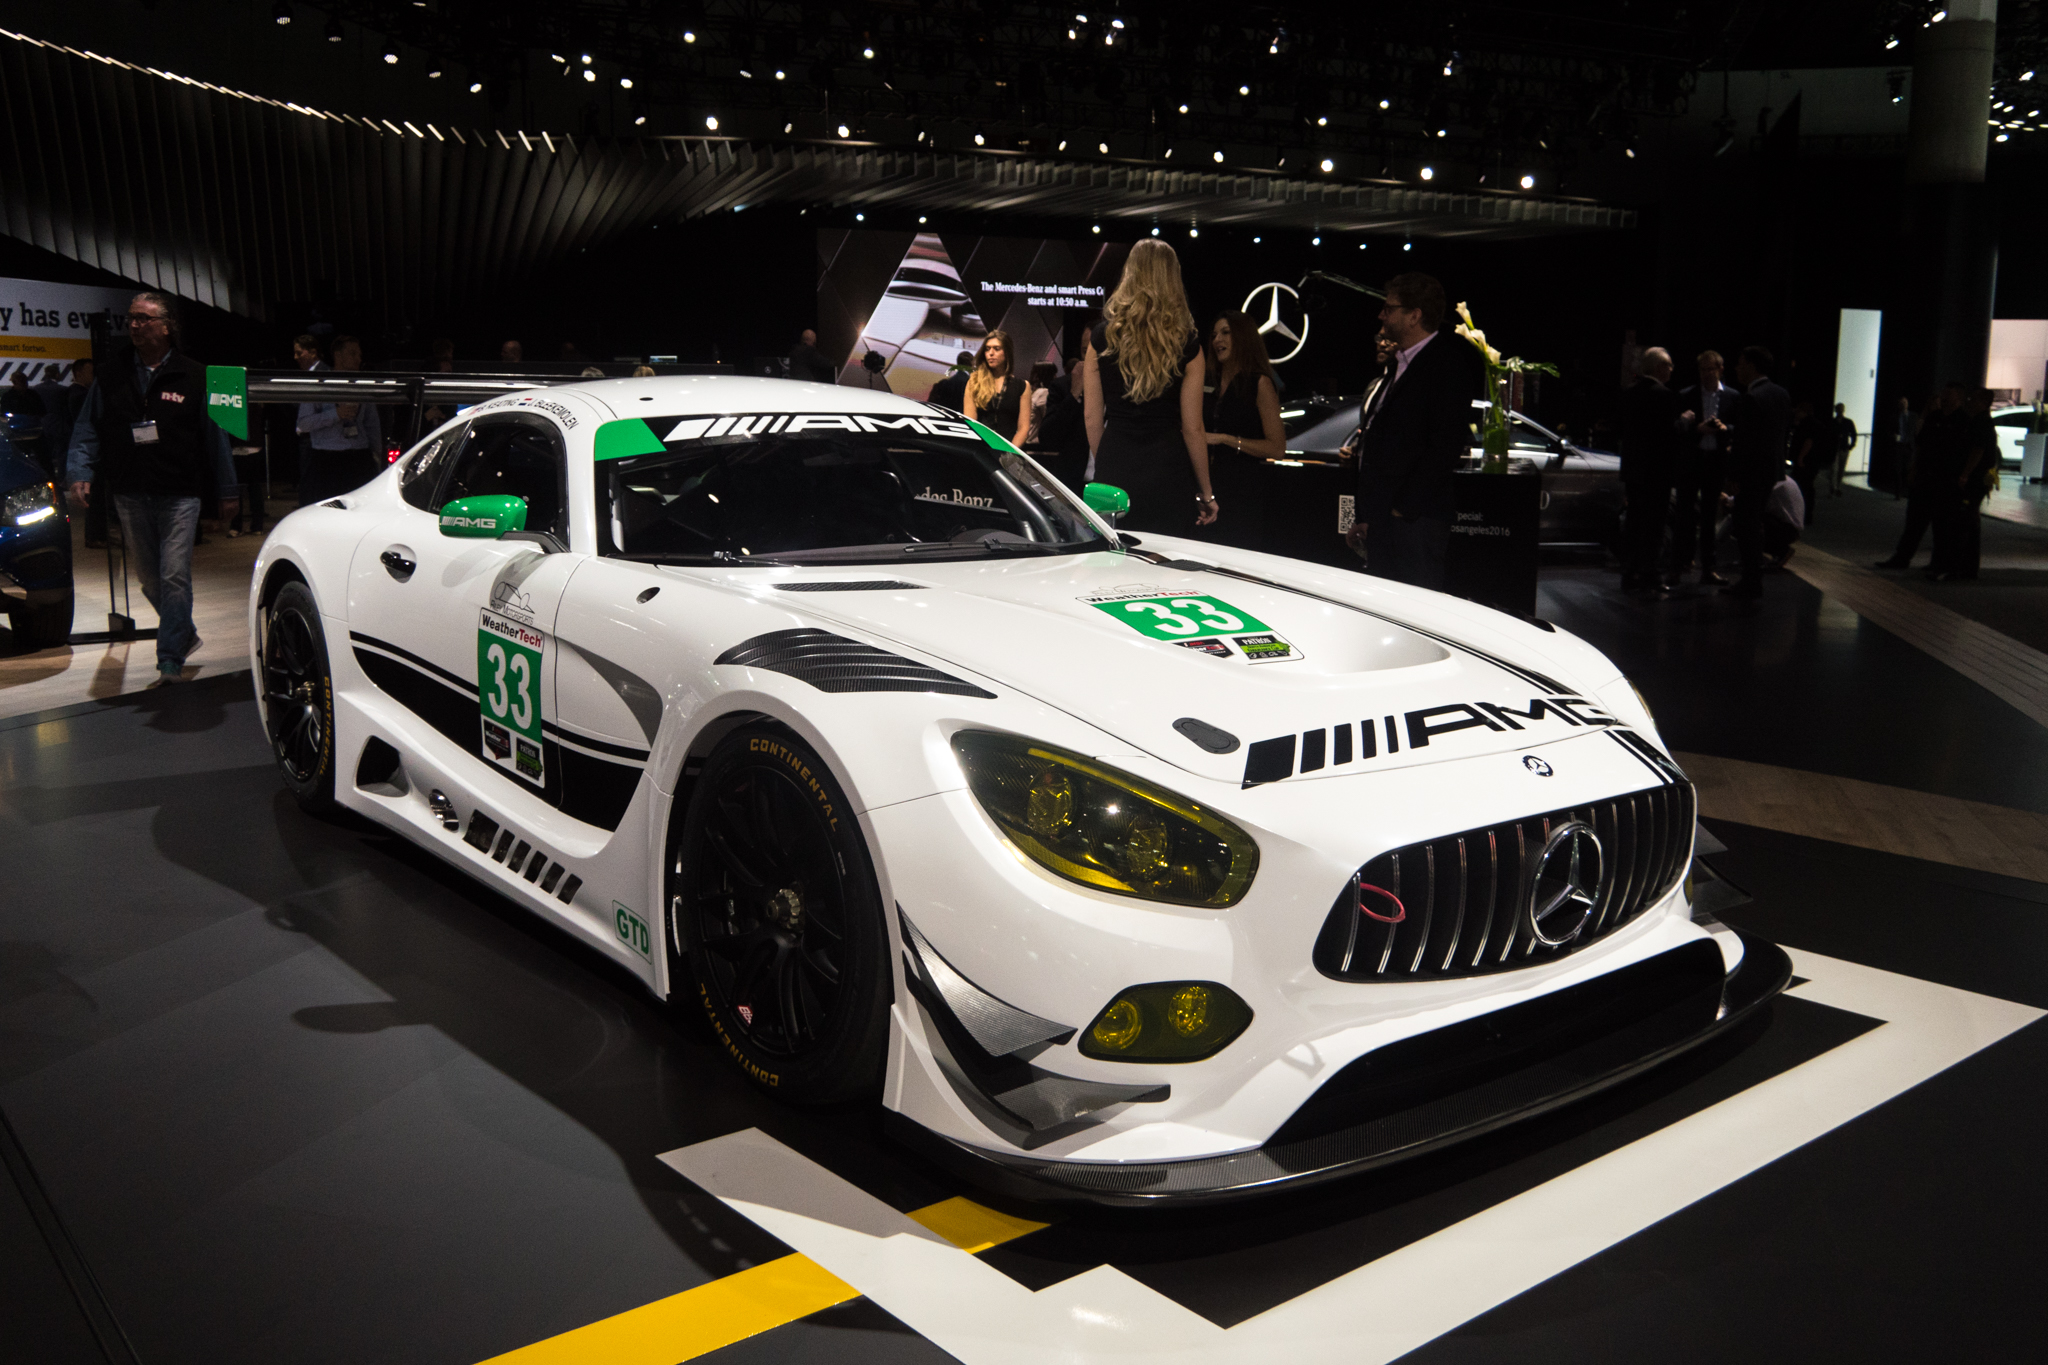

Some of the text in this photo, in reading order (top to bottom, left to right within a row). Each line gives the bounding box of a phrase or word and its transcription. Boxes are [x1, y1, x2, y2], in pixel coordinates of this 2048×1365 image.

[981, 281, 993, 292] The
[995, 282, 1043, 294] Mercedes-Benz
[1044, 285, 1057, 294] and
[1058, 287, 1077, 295] smart
[1077, 285, 1095, 296] Press
[1027, 297, 1046, 306] starts
[1047, 298, 1055, 306] at
[19, 302, 60, 328] has
[785, 415, 982, 440] AMG
[453, 516, 496, 529] AMG
[1456, 510, 1483, 521] pecial:
[1450, 525, 1510, 537] osangeles2016
[1085, 591, 1199, 602] WeatherTech
[482, 613, 542, 648] WeatherTech
[1125, 598, 1244, 635] 33
[487, 643, 532, 730] 33
[319, 676, 332, 775] CONTINENTAL
[1404, 698, 1632, 749] AMG
[750, 738, 838, 832] CONTINENTAL
[616, 908, 649, 955] GTD
[700, 982, 780, 1087] CONTINENTAL
